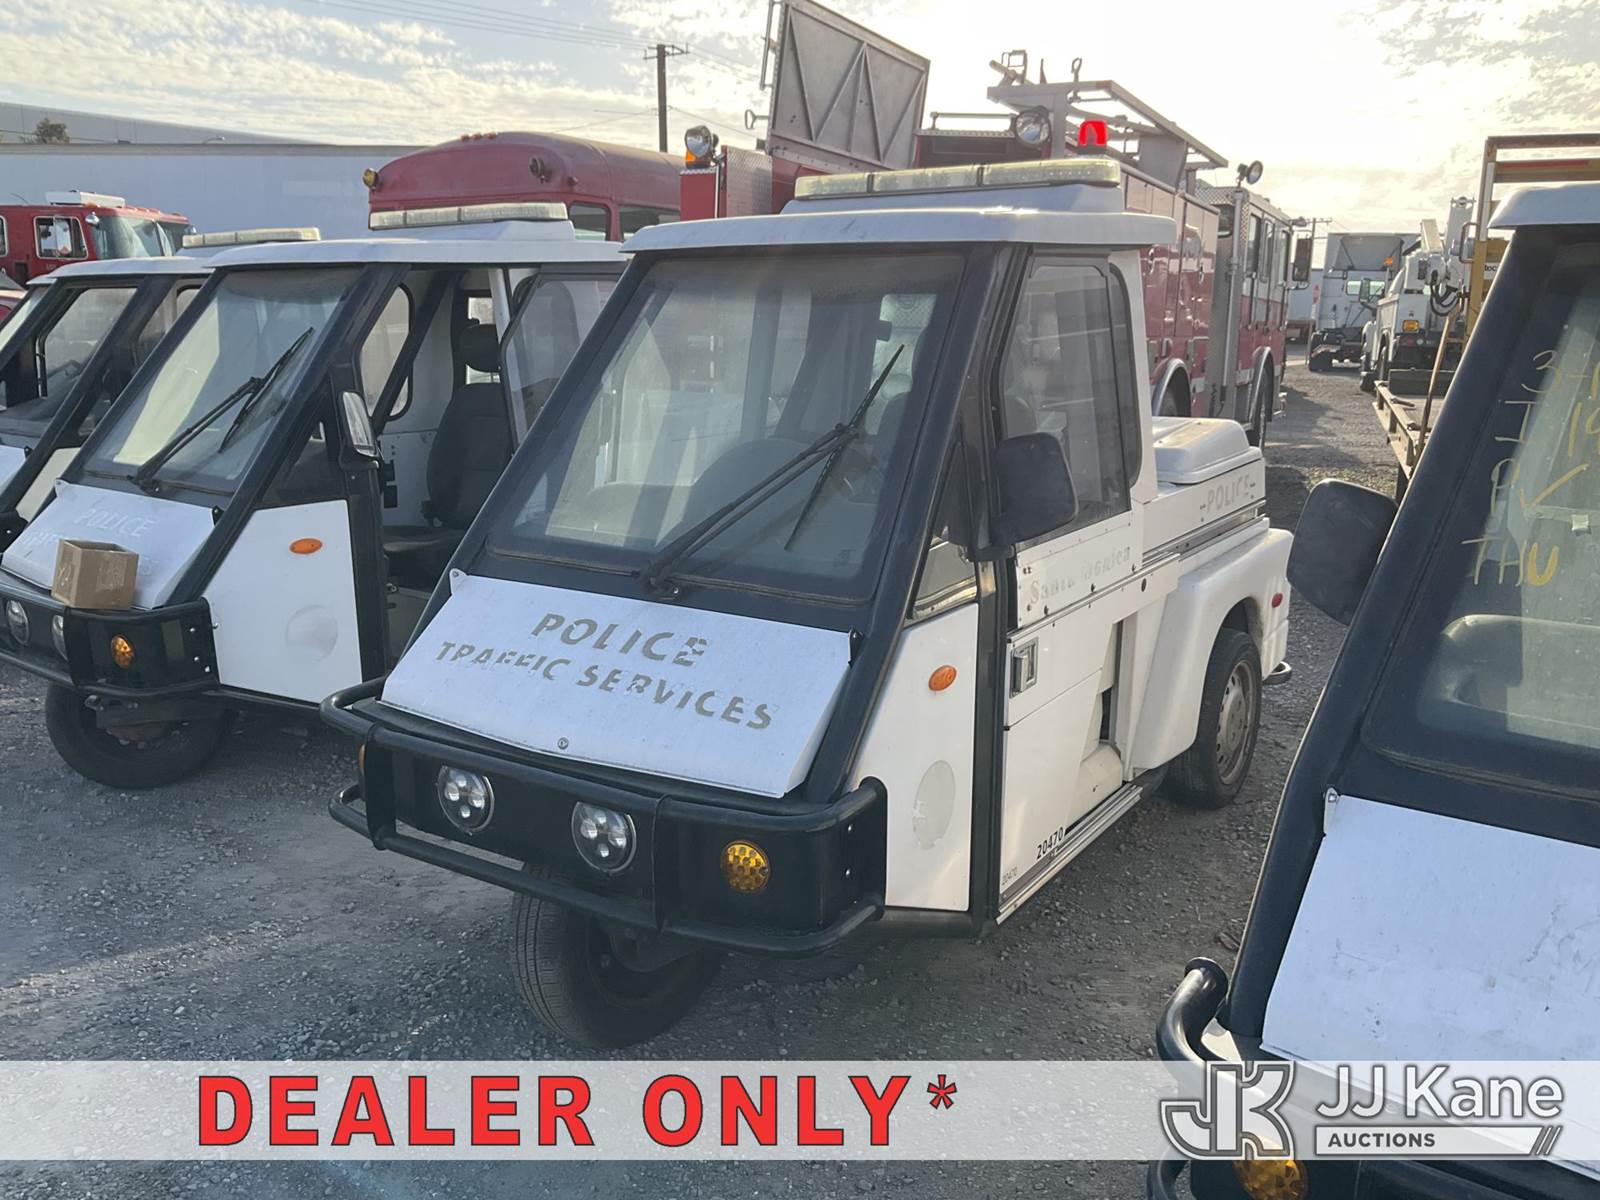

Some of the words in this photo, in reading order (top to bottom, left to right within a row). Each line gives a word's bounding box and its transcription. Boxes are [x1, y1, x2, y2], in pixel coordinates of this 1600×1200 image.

[1207, 474, 1250, 512] POLICE
[531, 613, 708, 667] POLICE
[435, 641, 571, 681] TRAFFIC
[576, 664, 773, 730] SERVICES
[1036, 826, 1064, 860] 20470
